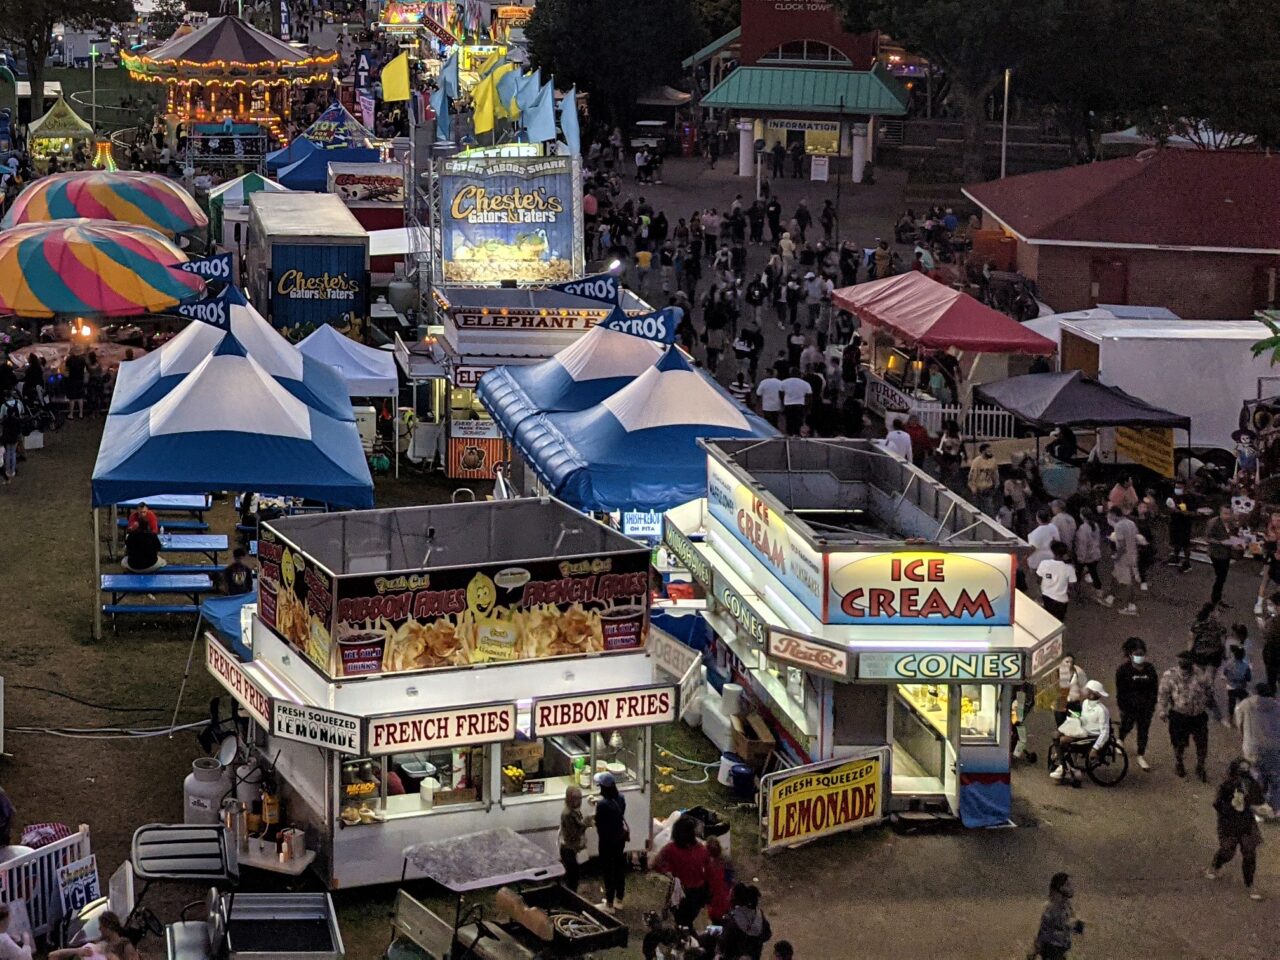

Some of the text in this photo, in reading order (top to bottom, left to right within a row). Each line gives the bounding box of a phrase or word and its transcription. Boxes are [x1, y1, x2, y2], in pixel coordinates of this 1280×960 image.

[775, 3, 805, 11] CLOCK
[769, 120, 837, 131] INFORMATION
[486, 163, 527, 176] KABOBS
[526, 160, 567, 174] SHARK
[451, 184, 564, 220] Chester's
[468, 209, 509, 224] Gators
[518, 209, 556, 224] Taters
[182, 257, 230, 278] GYROS
[278, 269, 360, 295] Chester's
[290, 288, 320, 299] Gators
[327, 288, 354, 300] Taters
[564, 276, 616, 300] GYROS
[179, 300, 226, 325] GYROS
[462, 315, 578, 329] ELEPHANT
[609, 315, 667, 340] GYROS
[751, 494, 769, 527] ICE
[737, 508, 786, 576] CREAM
[891, 558, 945, 582] ICE
[523, 571, 648, 609] FRENCH FRIES
[841, 587, 996, 620] CREAM
[338, 588, 467, 624] RIBBON FRIES
[723, 588, 764, 644] CONES
[895, 654, 1020, 678] CONES
[208, 642, 270, 721] FRENCH FRIES
[277, 705, 357, 730] FRESH SQUEEZED
[539, 692, 670, 728] RIBBON FRIES
[277, 714, 357, 749] LEMONADE
[373, 709, 510, 747] FRENCH FRIES
[778, 765, 873, 799] FRESH SQUEEZED
[773, 783, 877, 841] LEMONADE
[62, 875, 100, 913] ICE
